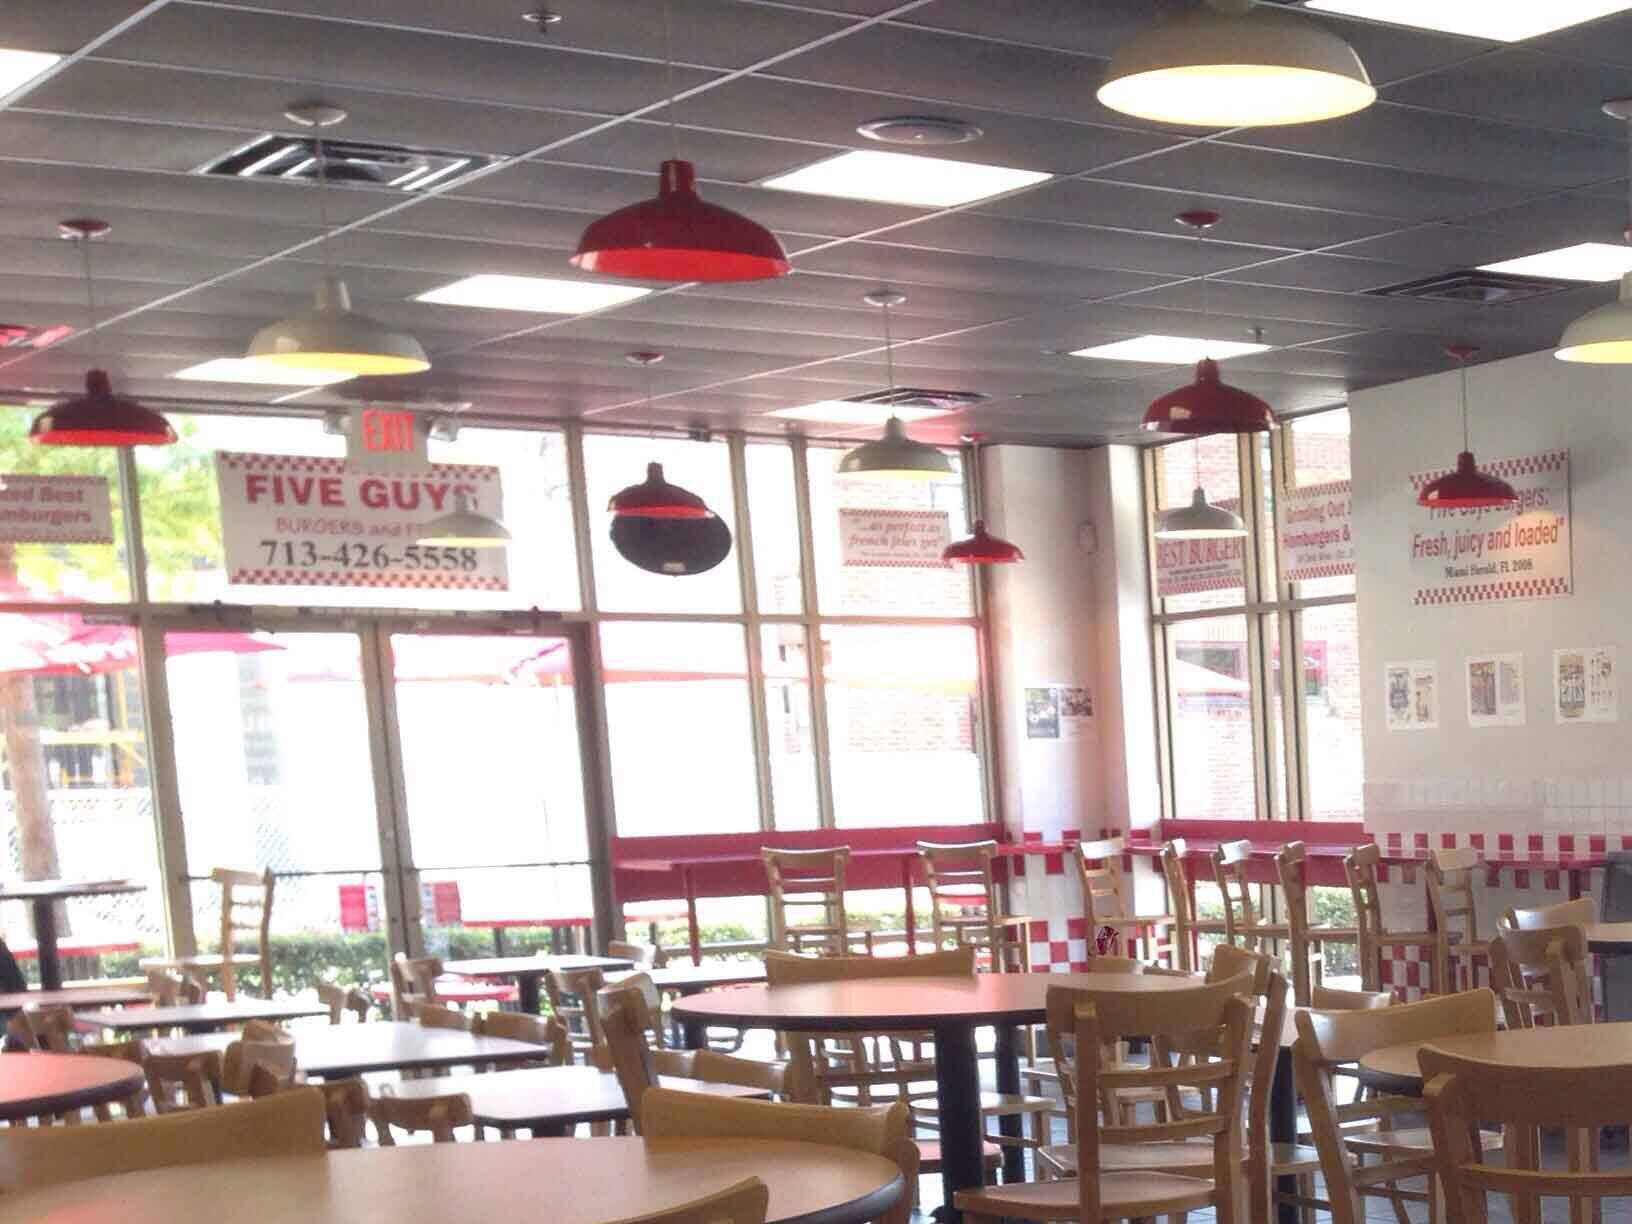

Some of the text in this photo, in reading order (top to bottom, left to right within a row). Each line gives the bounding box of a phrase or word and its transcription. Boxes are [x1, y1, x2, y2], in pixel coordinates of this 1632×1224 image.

[362, 408, 416, 451] EXIT
[246, 475, 345, 506] FIVE
[260, 540, 478, 571] 713-426-5558
[1412, 516, 1566, 560] Fresh, juicy and loaded"
